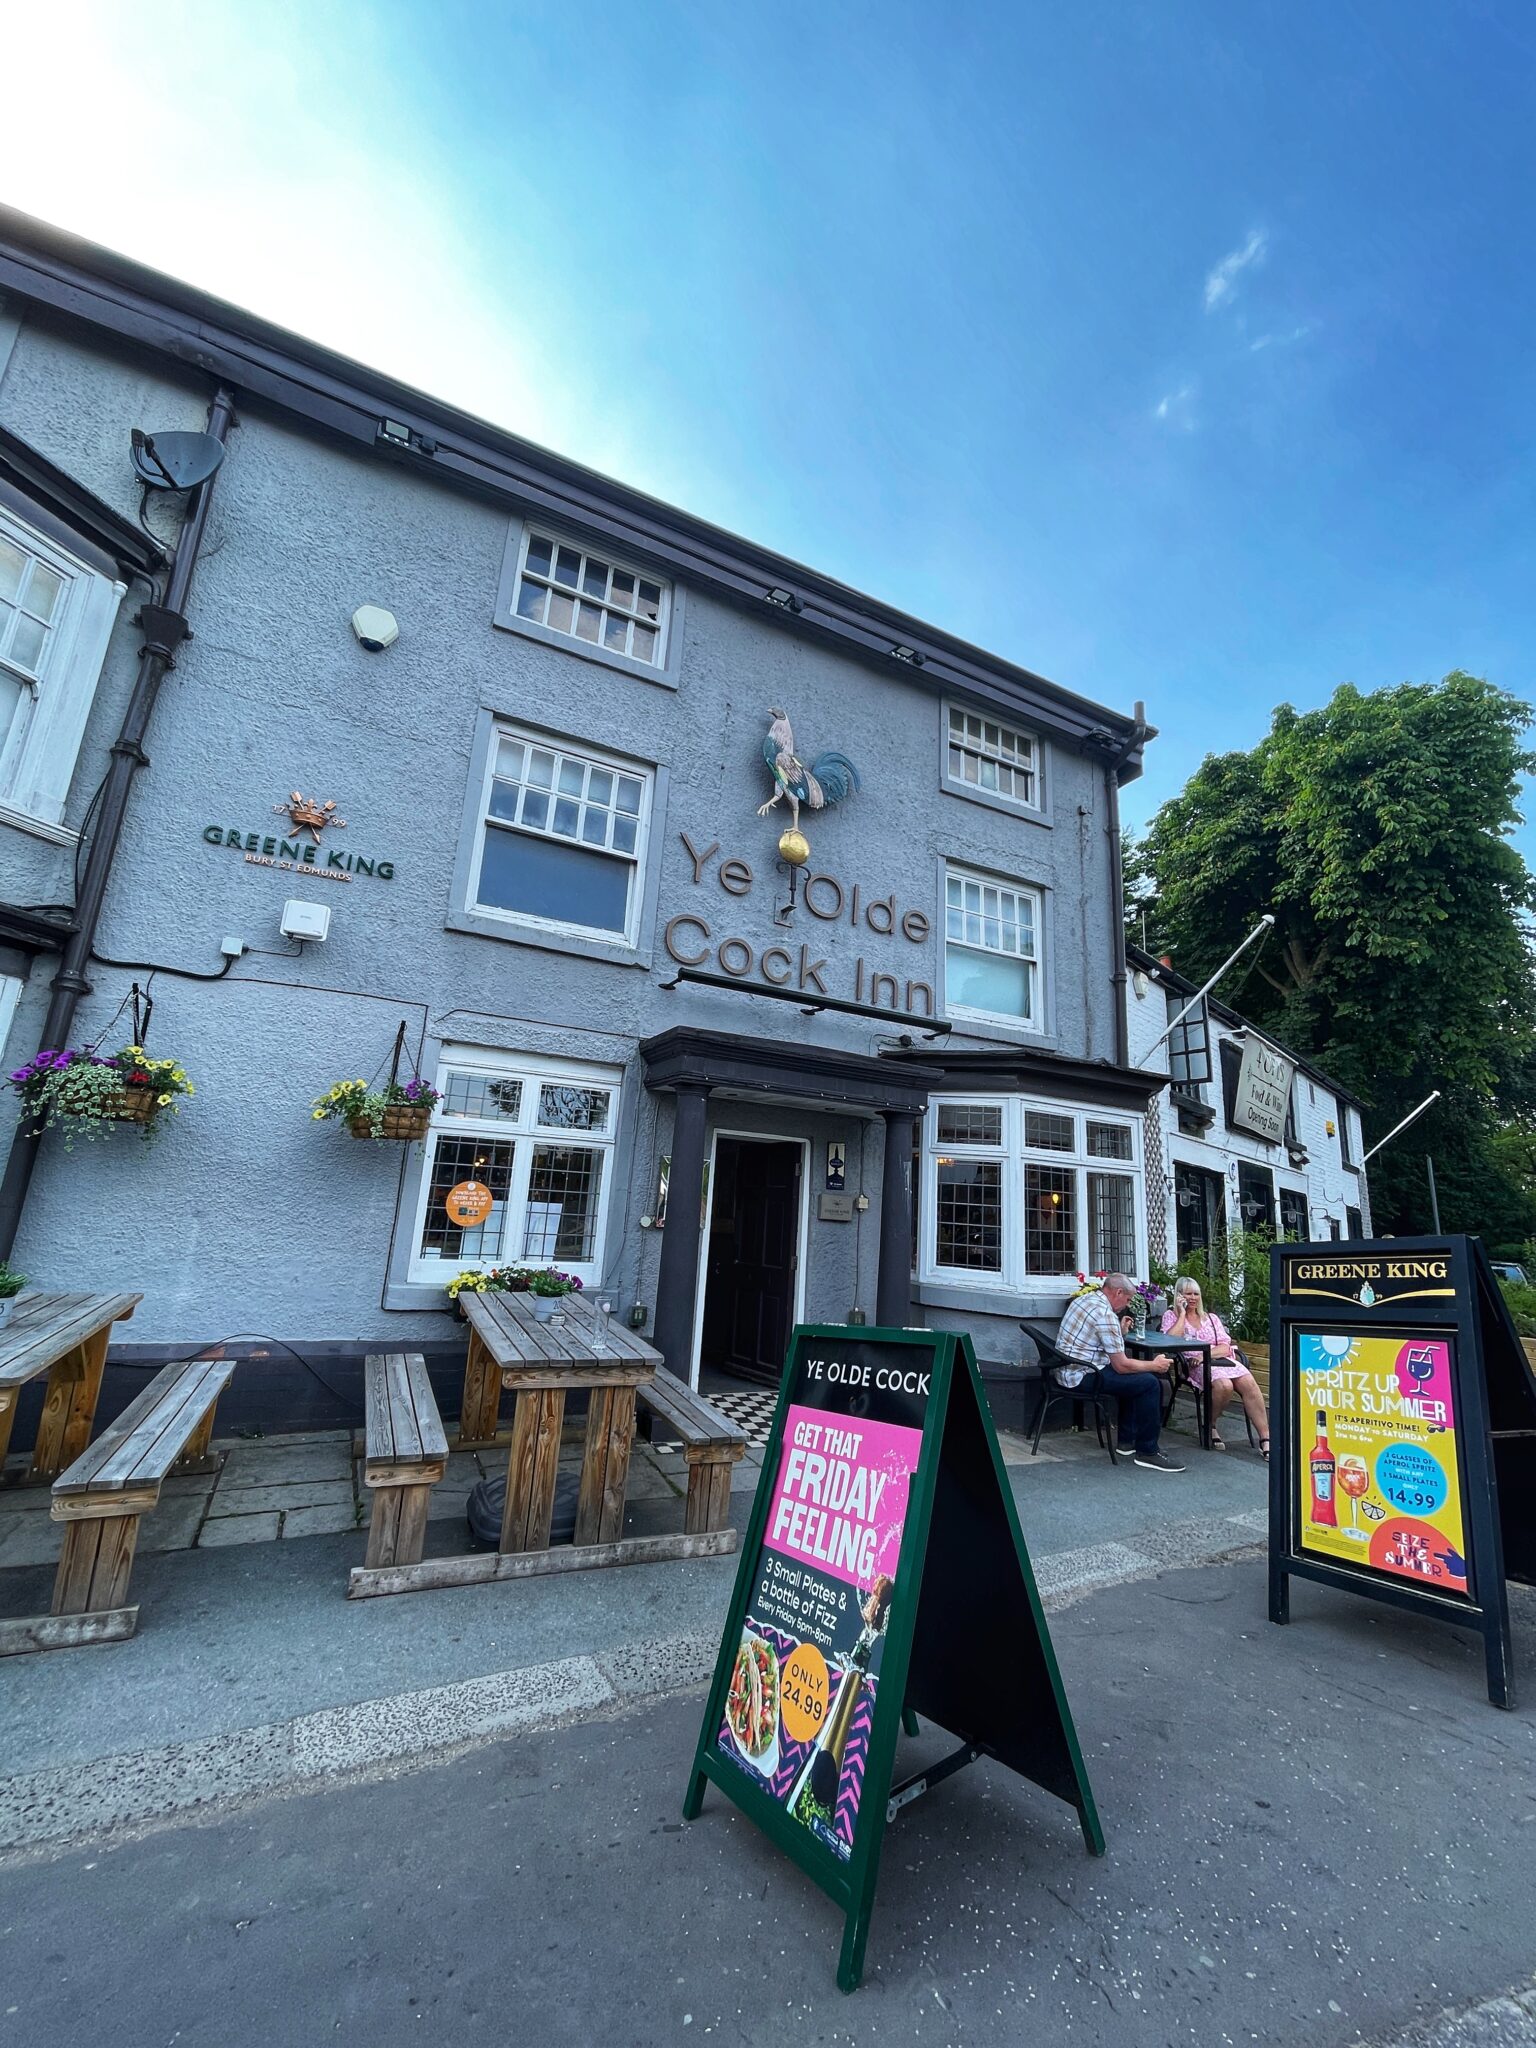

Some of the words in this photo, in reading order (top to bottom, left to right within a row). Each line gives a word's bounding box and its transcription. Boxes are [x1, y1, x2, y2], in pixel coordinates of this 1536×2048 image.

[272, 804, 286, 813] 17
[332, 818, 347, 827] 99
[203, 825, 318, 864] GREENE
[327, 850, 395, 880] KING
[245, 854, 276, 866] BURY
[280, 861, 294, 870] ST
[297, 864, 352, 882] EDMUNDS
[680, 832, 754, 895] Ye
[805, 873, 931, 943] Olde
[666, 914, 828, 994] Cock
[856, 957, 933, 1016] Inn
[1247, 1107, 1267, 1131] Opening
[1297, 1263, 1381, 1279] GREENE
[1386, 1261, 1448, 1279] KING
[807, 1359, 825, 1380] YE
[827, 1362, 872, 1387] OLDE
[875, 1369, 931, 1396] COCK
[1305, 1366, 1371, 1393] SPRITZ
[1374, 1374, 1400, 1394] UP
[1306, 1388, 1355, 1412] YOUR
[1361, 1392, 1447, 1423] SUMMER
[1334, 1414, 1349, 1424] IT'S
[1350, 1416, 1394, 1429] APERITIVO
[1395, 1421, 1420, 1433] TIME!
[1334, 1423, 1371, 1434] MONDAY
[1382, 1429, 1429, 1443] SATURDAY
[794, 1421, 823, 1449] GET
[824, 1427, 863, 1460] THAT
[1312, 1462, 1334, 1472] APEROL
[1383, 1459, 1409, 1469] APEROL
[1411, 1462, 1436, 1473] SPRITZ
[1391, 1452, 1421, 1464] GLASSES
[1423, 1457, 1433, 1465] OF
[782, 1448, 886, 1523] FRIDAY
[1388, 1472, 1412, 1483] SMALL
[1412, 1476, 1438, 1488] PLATES
[1387, 1487, 1436, 1509] 14.99
[772, 1497, 878, 1581] FEELING
[1392, 1531, 1430, 1549] SEIZE
[1396, 1543, 1427, 1560] THE
[1385, 1551, 1442, 1577] SUMMER
[766, 1557, 772, 1573] 3
[773, 1561, 800, 1588] Small
[802, 1574, 837, 1605] Plates
[838, 1591, 847, 1612] &
[761, 1579, 769, 1593] a
[770, 1579, 800, 1610] bottle
[801, 1599, 815, 1617] of
[815, 1604, 838, 1630] Fizz
[757, 1596, 775, 1616] Every
[775, 1604, 797, 1628] Friday
[796, 1617, 833, 1646] 5pm-8pm
[791, 1663, 823, 1693] ONLY
[783, 1679, 823, 1722] 24.99
